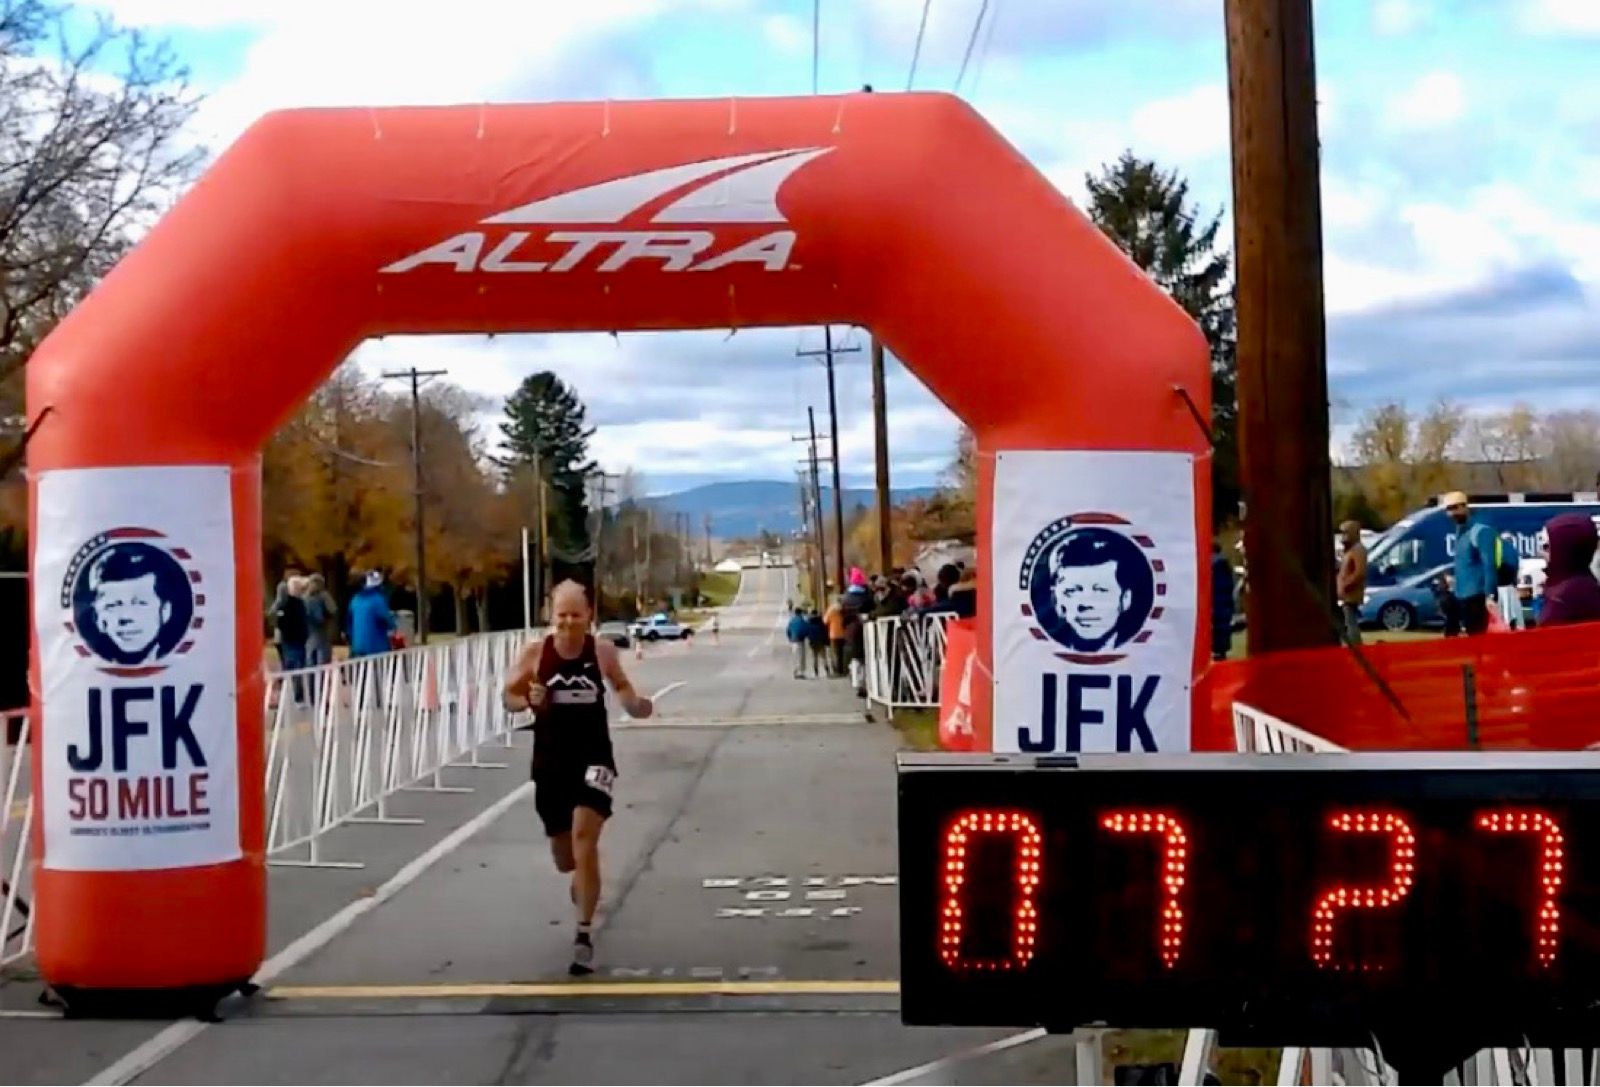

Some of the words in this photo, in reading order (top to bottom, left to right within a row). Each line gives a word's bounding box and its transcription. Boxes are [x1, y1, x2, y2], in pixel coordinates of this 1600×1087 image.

[378, 230, 797, 273] ALTRA
[67, 684, 208, 772] JFK
[1018, 673, 1161, 753] JFK
[69, 778, 109, 820] 50
[118, 773, 211, 820] MILE
